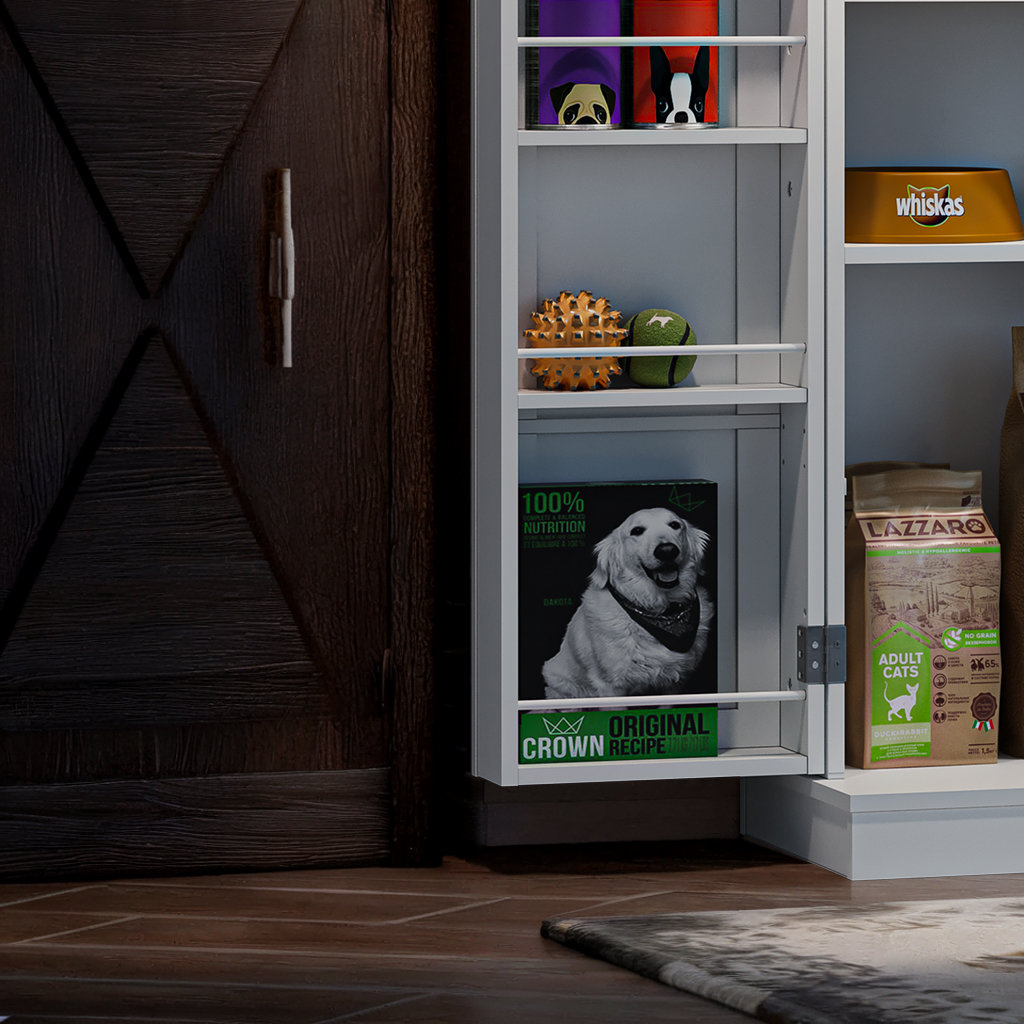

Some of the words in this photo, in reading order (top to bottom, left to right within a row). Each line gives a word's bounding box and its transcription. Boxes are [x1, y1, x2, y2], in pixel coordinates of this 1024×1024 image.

[896, 192, 965, 216] whiskas
[523, 491, 584, 514] 100%
[524, 521, 586, 534] NUTRITION
[866, 518, 986, 538] LAZZARO
[878, 652, 923, 665] ADULT
[883, 666, 919, 678] CATS
[609, 713, 710, 738] ORIGINAL
[523, 735, 604, 759] CROWN
[609, 738, 666, 756] RECIPE
